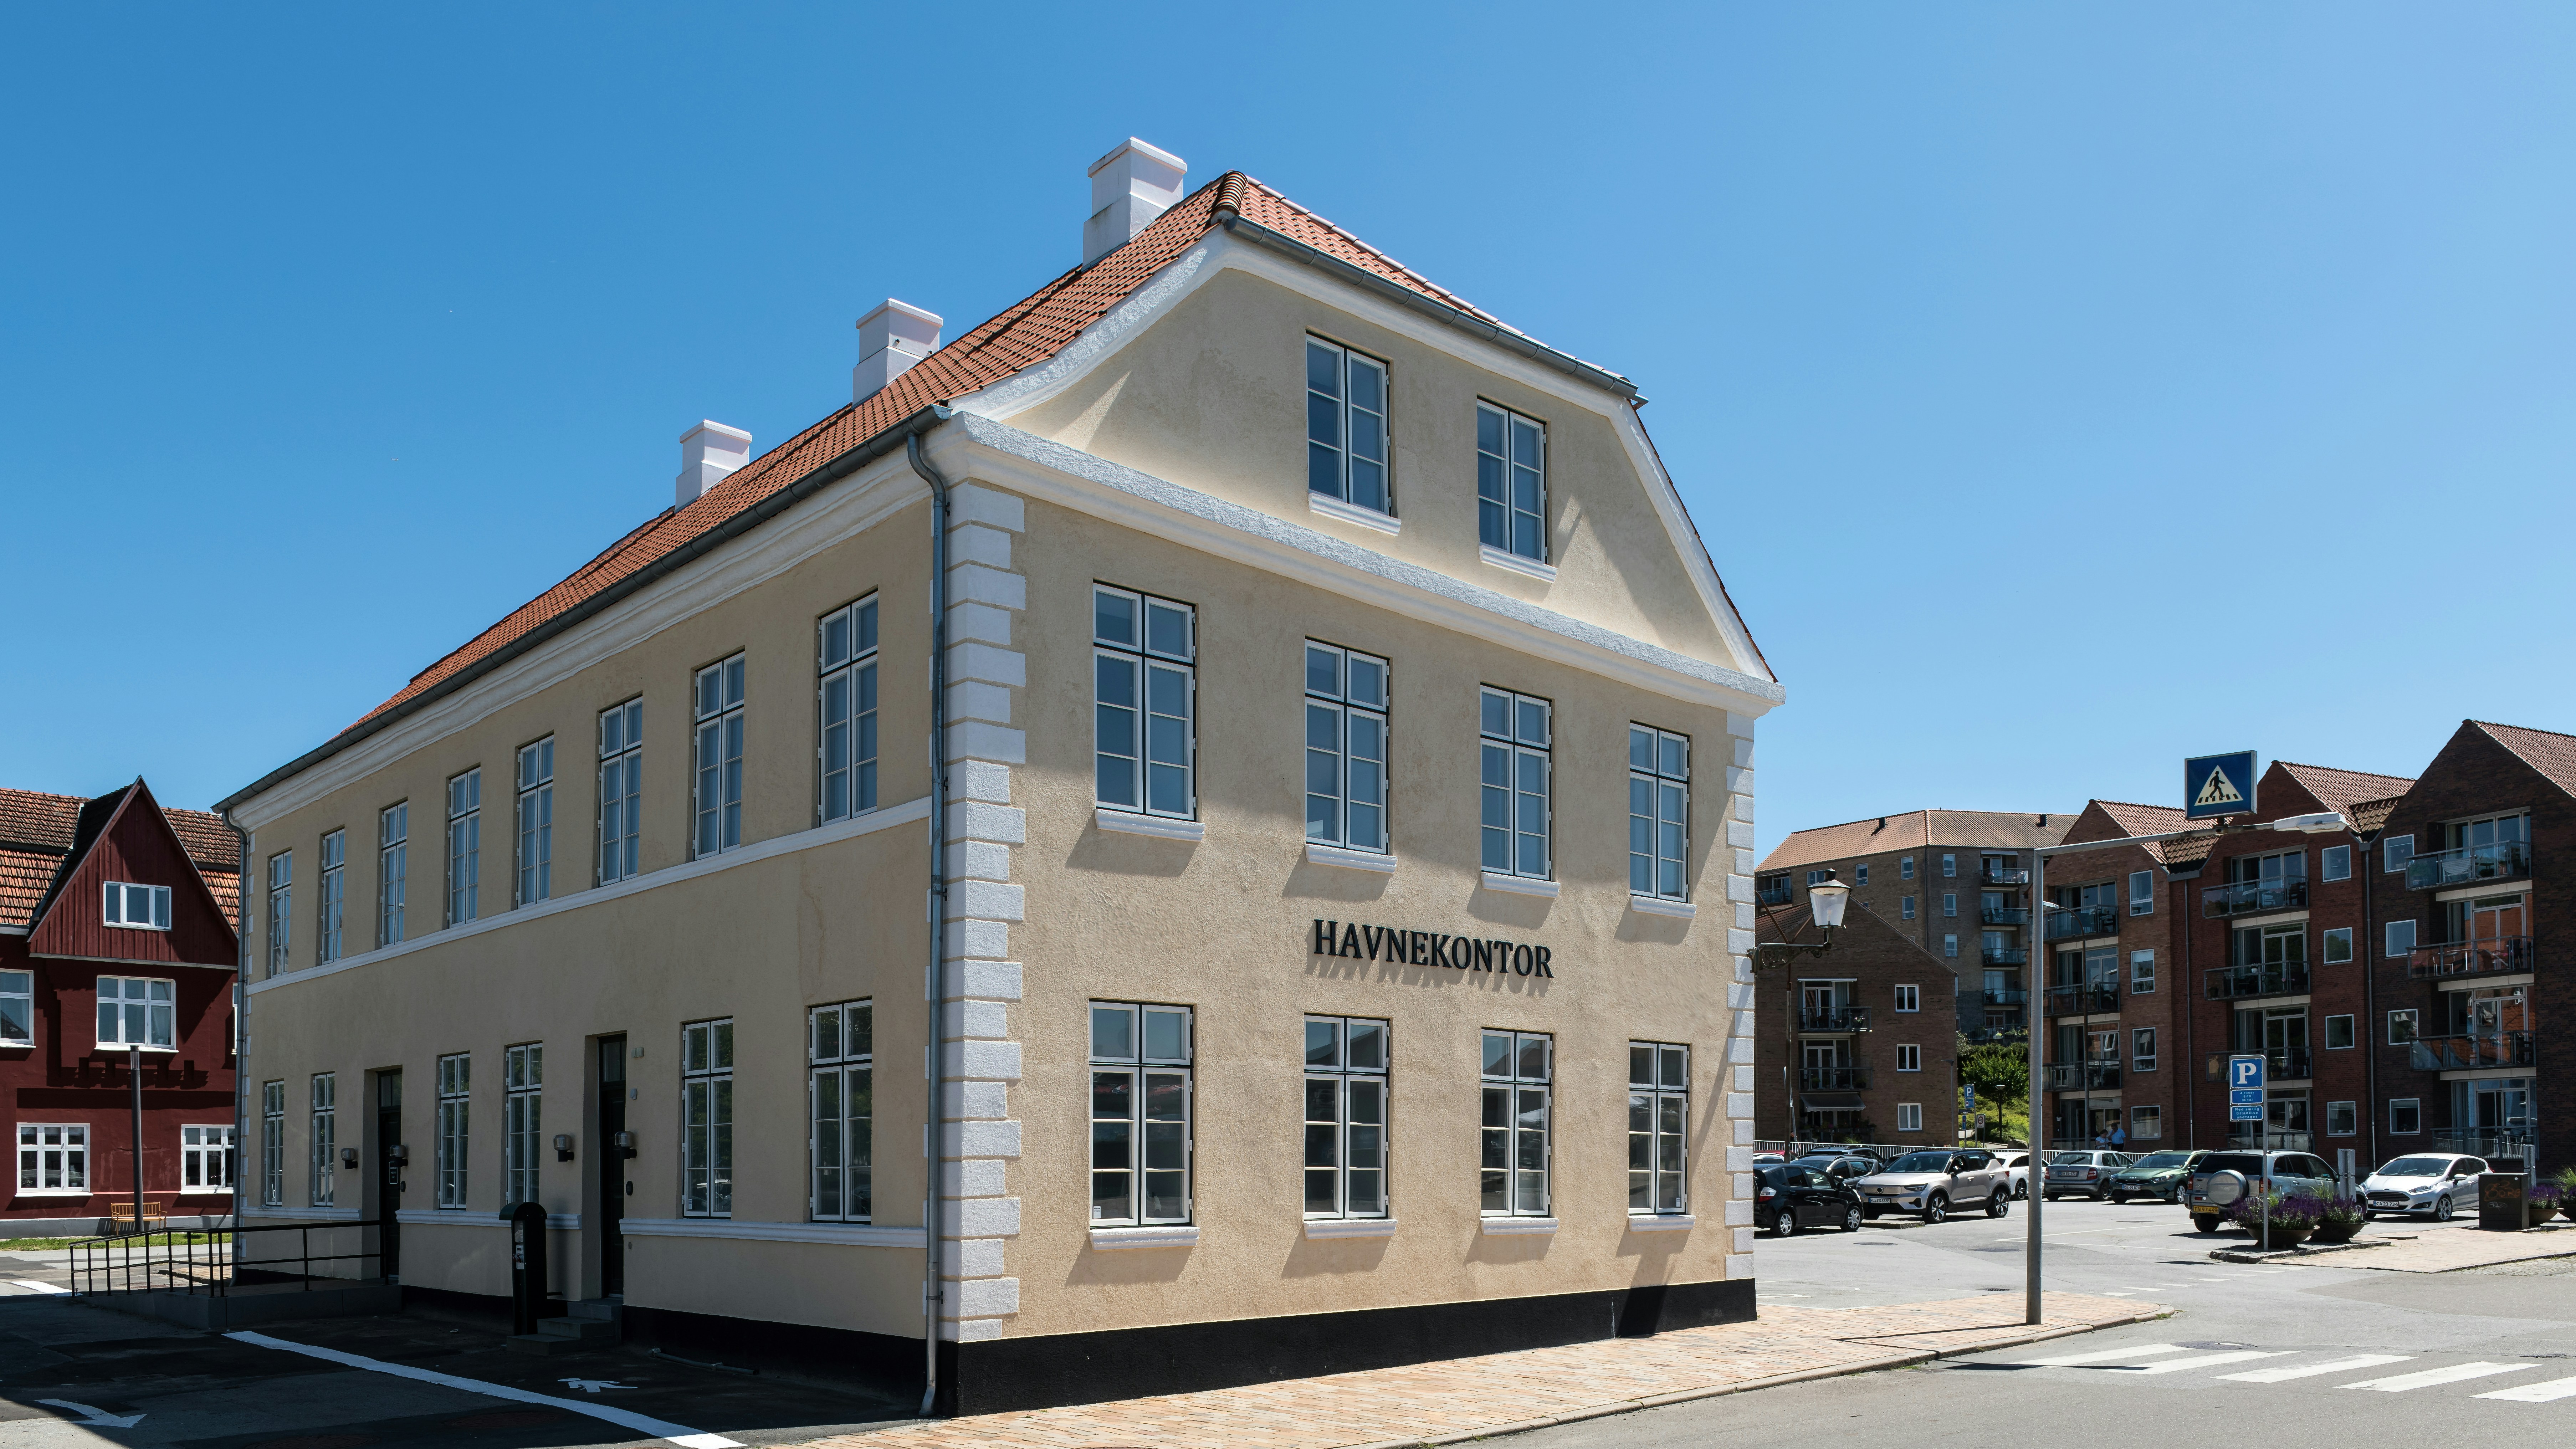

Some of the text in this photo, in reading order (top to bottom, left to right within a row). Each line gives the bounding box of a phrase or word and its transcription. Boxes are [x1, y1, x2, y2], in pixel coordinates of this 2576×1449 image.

[1314, 919, 1555, 978] HAVNEKONTOR
[2237, 1063, 2257, 1084] P
[1967, 1087, 1971, 1096] P
